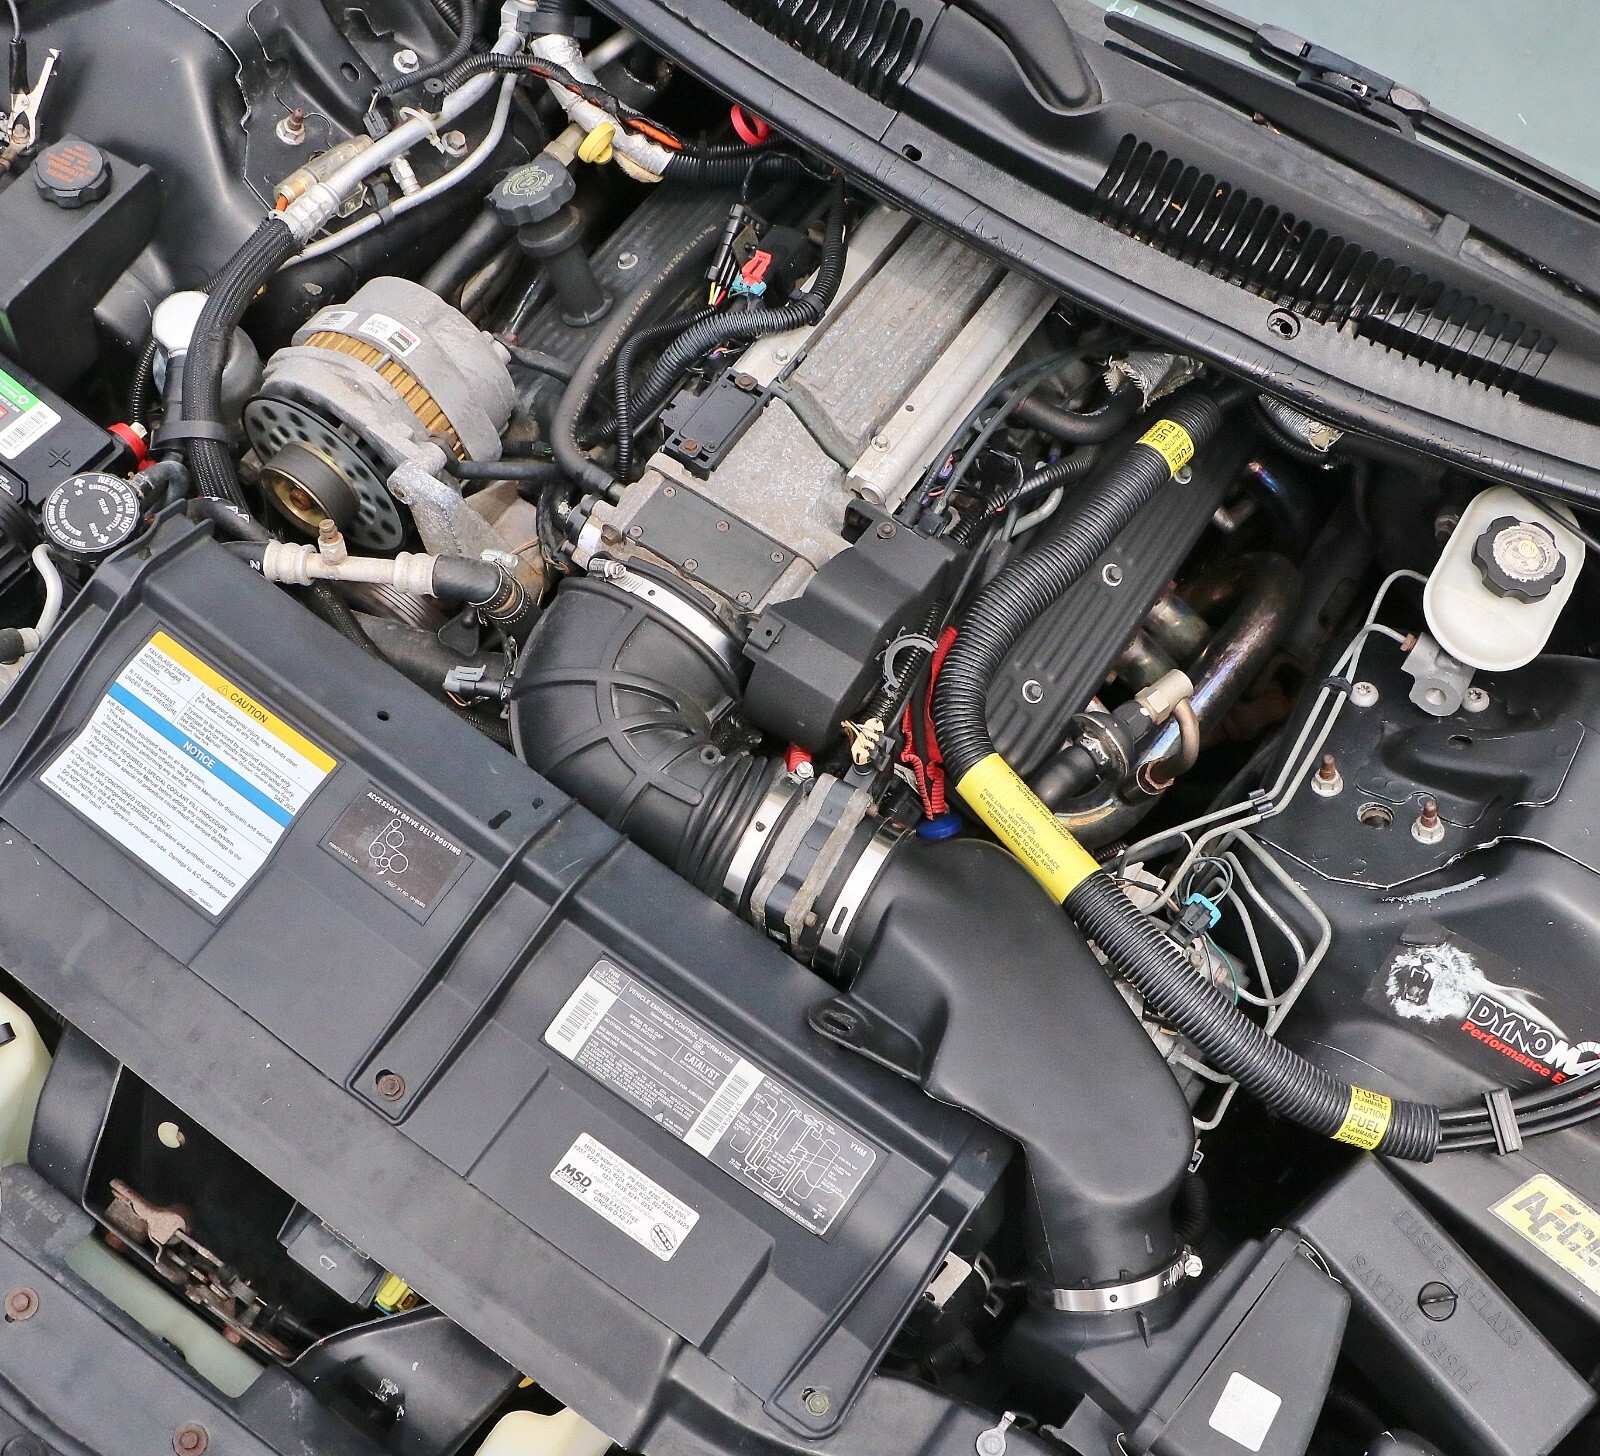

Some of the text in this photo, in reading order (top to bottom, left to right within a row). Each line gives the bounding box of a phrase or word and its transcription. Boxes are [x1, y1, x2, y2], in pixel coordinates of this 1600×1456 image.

[1151, 421, 1175, 447] FUEL
[1161, 429, 1183, 453] CAUTION
[1170, 442, 1193, 466] FUEL
[88, 484, 109, 492] CHECK
[109, 490, 122, 504] LEVEL
[58, 498, 82, 536] CLOSED SYSTEM
[98, 476, 134, 533] NEVER OPEN HOT
[54, 528, 69, 542] VENT
[105, 513, 122, 531] BOTTLE
[143, 652, 182, 683] WITHOUT ENGINE
[147, 647, 191, 681] FAN BLADE STARTS
[106, 699, 115, 707] AIR
[124, 674, 177, 715] UNDER HIGH PRESSURE
[143, 680, 175, 706] REFRIGERANT
[229, 691, 268, 723] CAUTION
[204, 703, 217, 714] blade
[225, 718, 236, 728] start
[240, 731, 249, 739] any
[204, 696, 216, 707] help
[215, 704, 228, 715] avoid
[227, 713, 247, 730] personal
[259, 738, 272, 749] keep
[271, 746, 286, 759] hands
[90, 725, 101, 735] THIS
[100, 733, 120, 750] VEHICLE
[119, 748, 143, 768] REQUIRES
[146, 769, 167, 786] SPECIAL
[166, 784, 188, 802] COOLANT
[188, 800, 199, 811] FILL
[182, 741, 216, 769] NOTICE
[367, 790, 461, 856] ACCESSORY DRIVE BELT ROUTING
[979, 792, 1055, 874] BY RETAINER STRAP TO HELP AVOID
[983, 787, 996, 801] FUEL
[994, 800, 1008, 815] LINES
[1007, 813, 1021, 828] MUST
[1026, 834, 1039, 849] HELD
[1043, 853, 1059, 870] PLACE
[986, 809, 1039, 866] POTENTIAL FIRE HAZARD
[1015, 812, 1036, 835] CAUTION
[627, 986, 734, 1064] VEHICLE EMISSION CONTROL INFORMATION
[1461, 1021, 1550, 1077] Performance
[682, 1051, 720, 1082] CATALYST
[1353, 1102, 1386, 1120] CAUTION
[1354, 1094, 1387, 1110] FLAMMABLE
[1355, 1088, 1388, 1104] FUEL
[1344, 1124, 1378, 1140] FLAMMABLE
[1349, 1113, 1381, 1133] FUEL
[849, 1142, 867, 1157] YHM
[1339, 1131, 1373, 1147] CAUTION
[595, 1152, 613, 1167] Blaster
[560, 1162, 592, 1189] MSD
[587, 1139, 597, 1148] This
[617, 1160, 639, 1178] equipped
[639, 1175, 649, 1184] with
[662, 1192, 672, 1200] the
[670, 1198, 692, 1216] following
[589, 1172, 604, 1185] Legal
[621, 1194, 631, 1203] and
[630, 1201, 656, 1221] installation
[593, 1195, 613, 1212] ORDER
[593, 1189, 639, 1223] CARB EXECUTIVE
[762, 1191, 816, 1230] EMISSION HOSE ROUTING
[1512, 1191, 1600, 1267] ACCE
[1393, 1208, 1525, 1348] FUSES RELAYS
[1348, 1253, 1479, 1393] FUSES RELAYS
